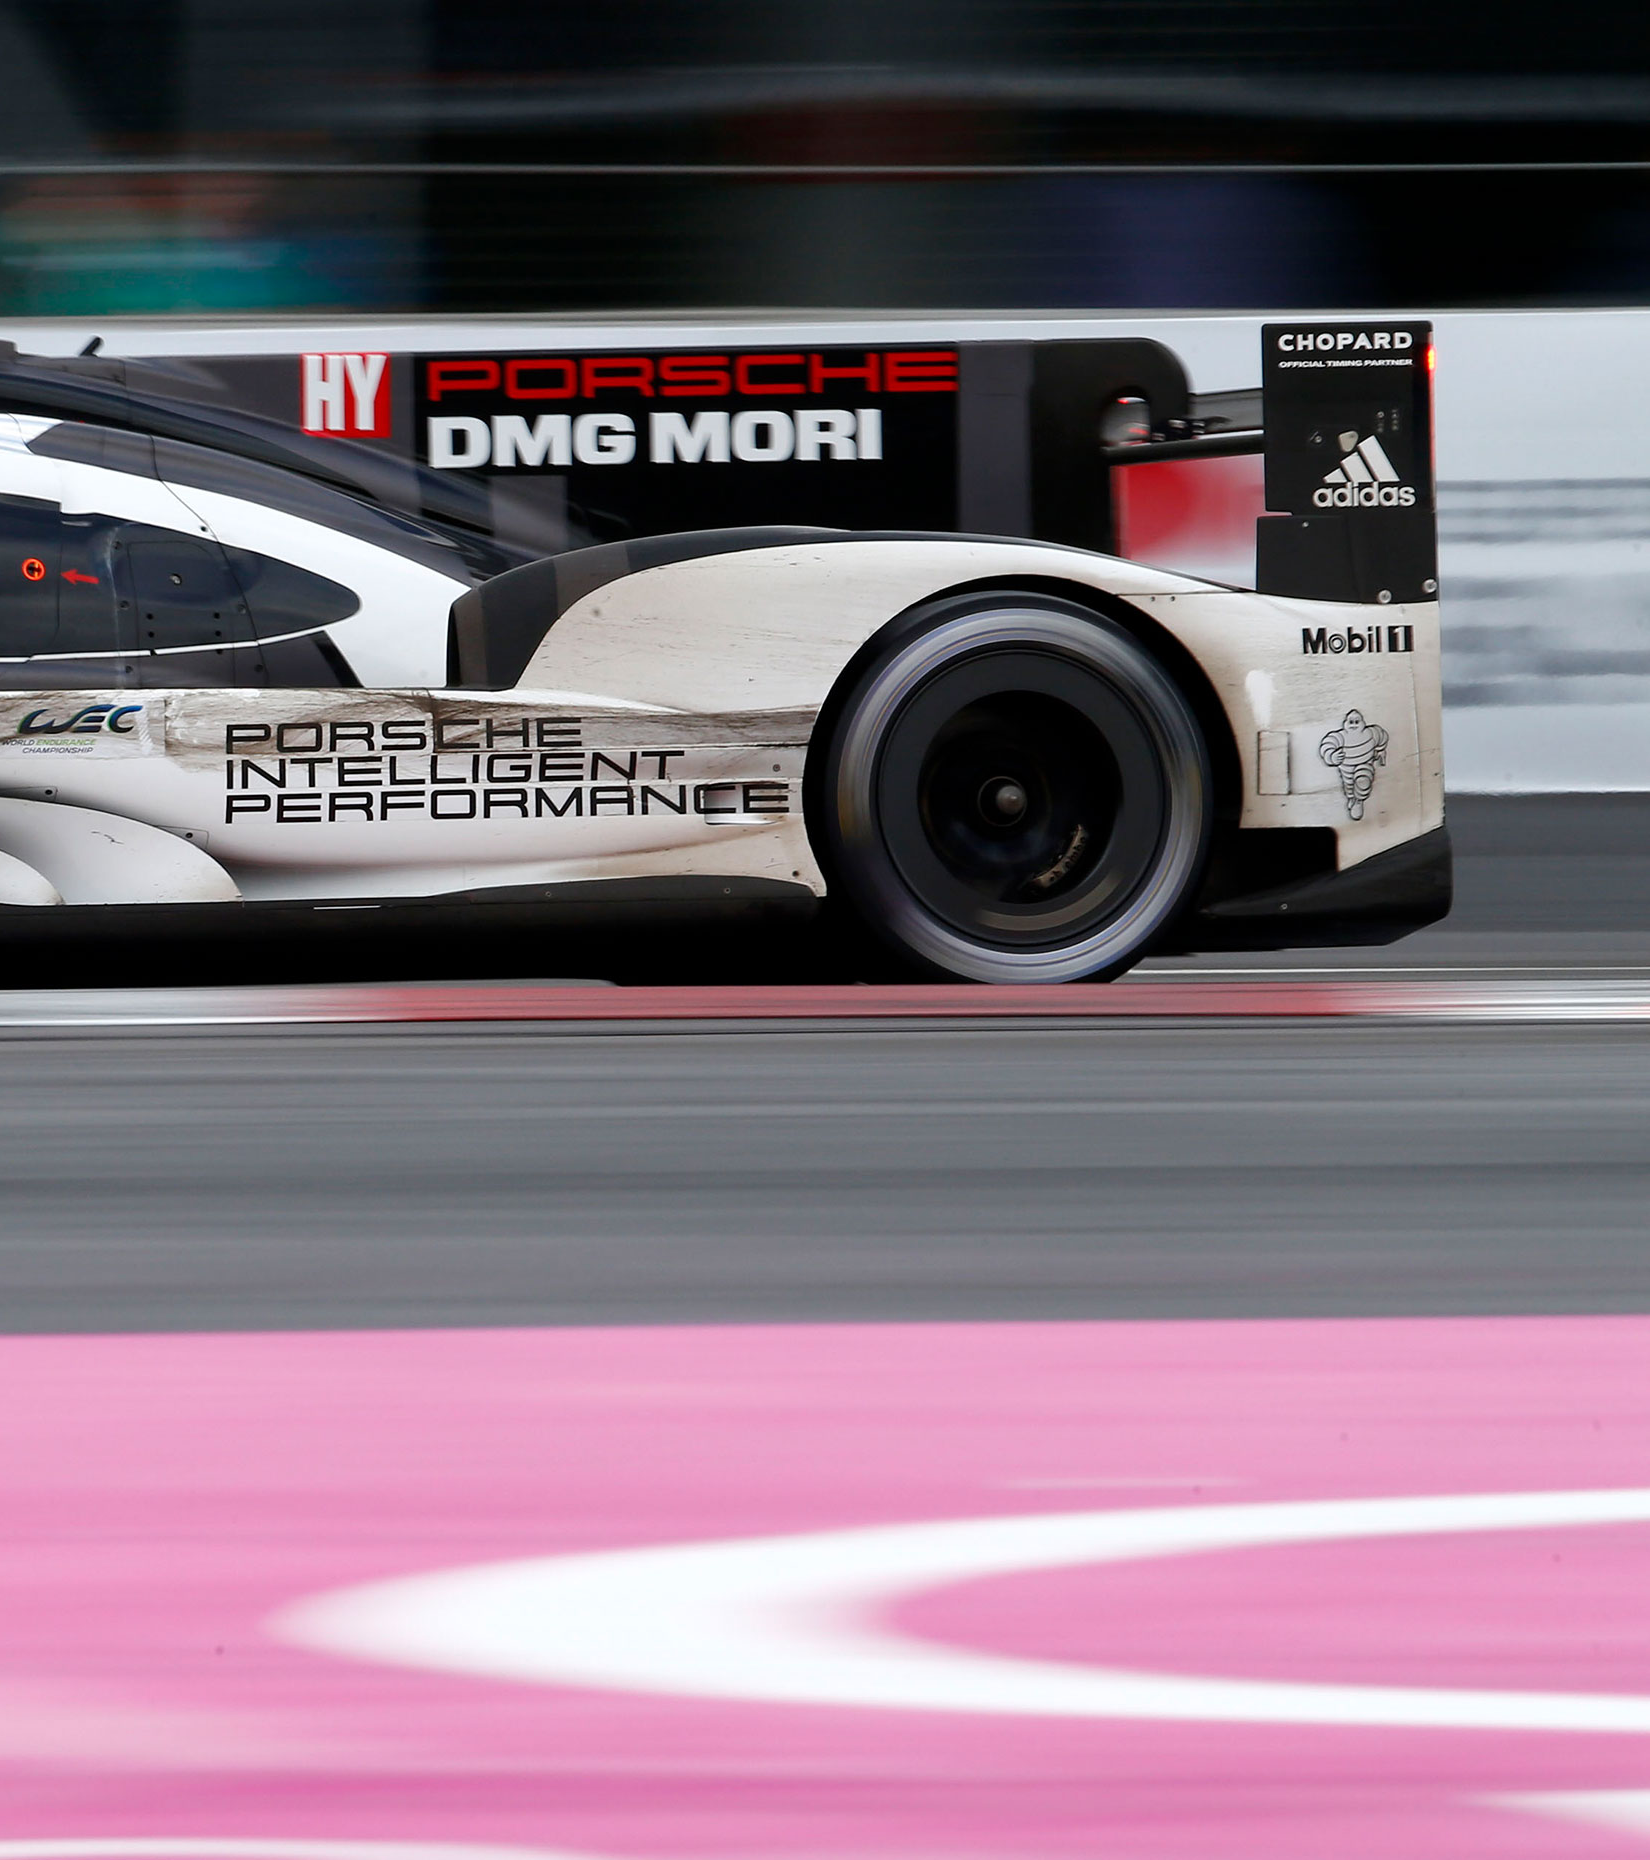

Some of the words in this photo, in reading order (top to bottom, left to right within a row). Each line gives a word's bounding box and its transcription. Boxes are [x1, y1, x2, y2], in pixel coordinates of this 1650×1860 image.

[1278, 332, 1414, 351] CHOPARD
[426, 352, 959, 400] PORSCHE
[1278, 360, 1326, 369] OFFICIAL
[1326, 360, 1363, 368] TIMING
[1364, 359, 1414, 367] PARTNER
[303, 353, 387, 432] HY
[428, 411, 636, 468] DMG
[649, 408, 882, 465] MORI
[1313, 481, 1417, 508] adidas
[1302, 625, 1382, 655] Mobil
[17, 703, 144, 735] WEC
[225, 716, 583, 754] PORSCHE
[225, 750, 686, 790] INTELLIGENT
[225, 783, 790, 825] PERFORMANCE
